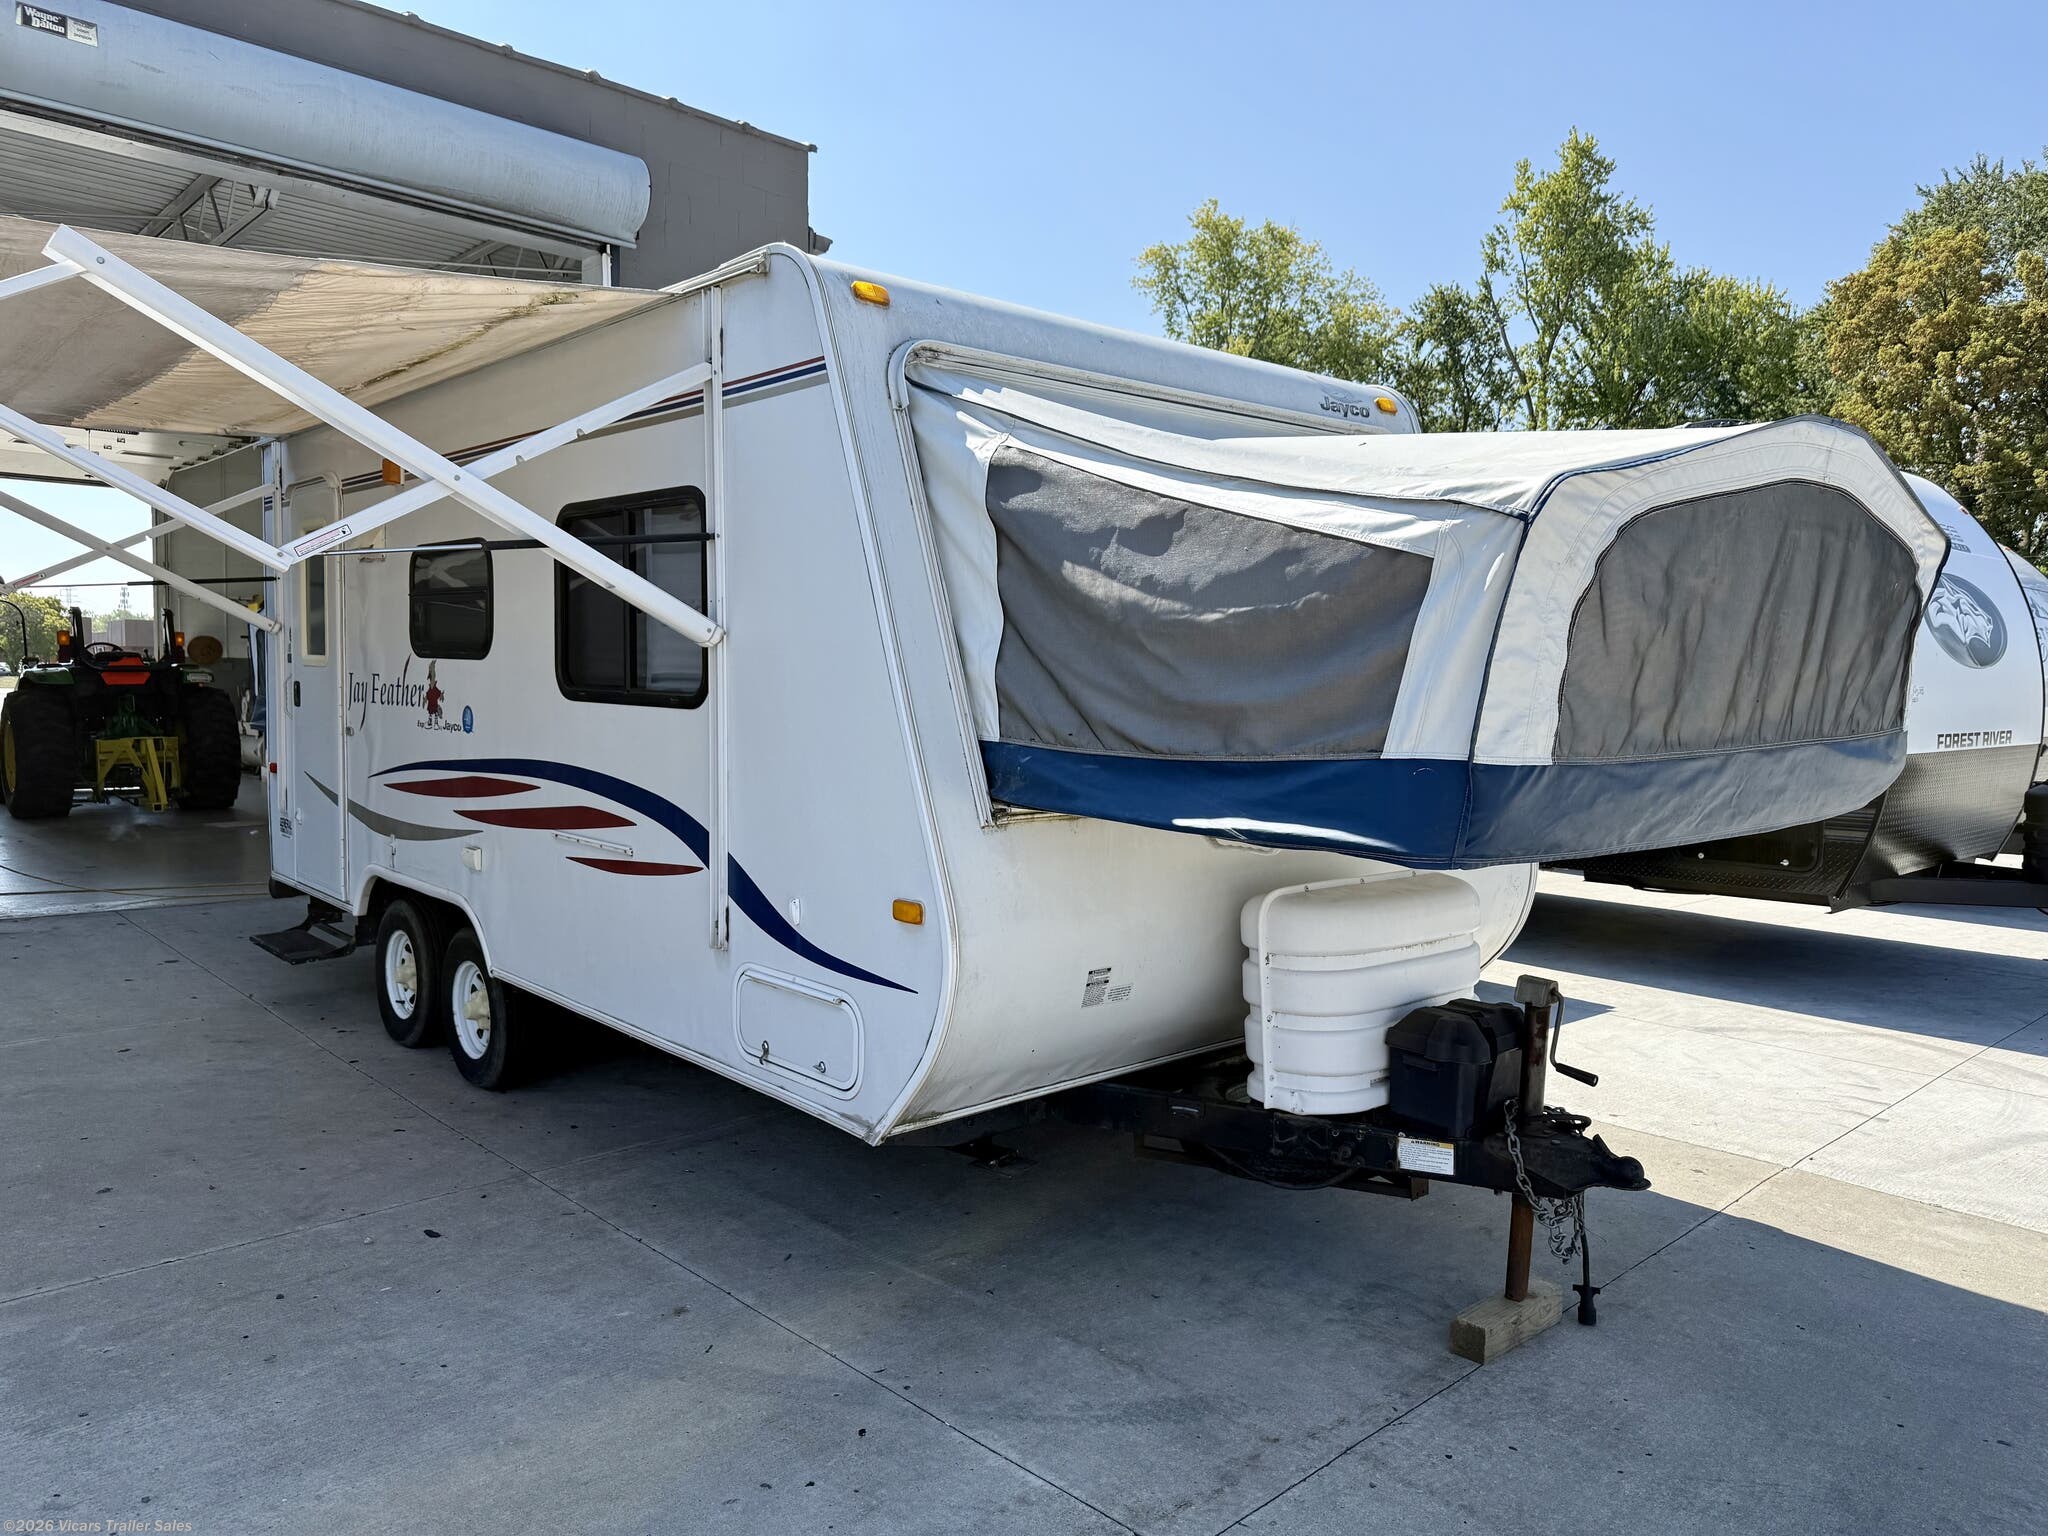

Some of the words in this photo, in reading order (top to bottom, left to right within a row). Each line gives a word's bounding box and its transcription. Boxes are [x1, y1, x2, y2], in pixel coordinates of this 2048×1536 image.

[24, 6, 59, 23] Wayne
[31, 16, 65, 34] Dalton
[1320, 396, 1370, 418] Jayco
[348, 672, 368, 731] Jay
[371, 653, 424, 707] Feather
[443, 719, 462, 733] Jayco
[1936, 732, 1981, 749] FOREST
[1982, 730, 2012, 745] RIVER
